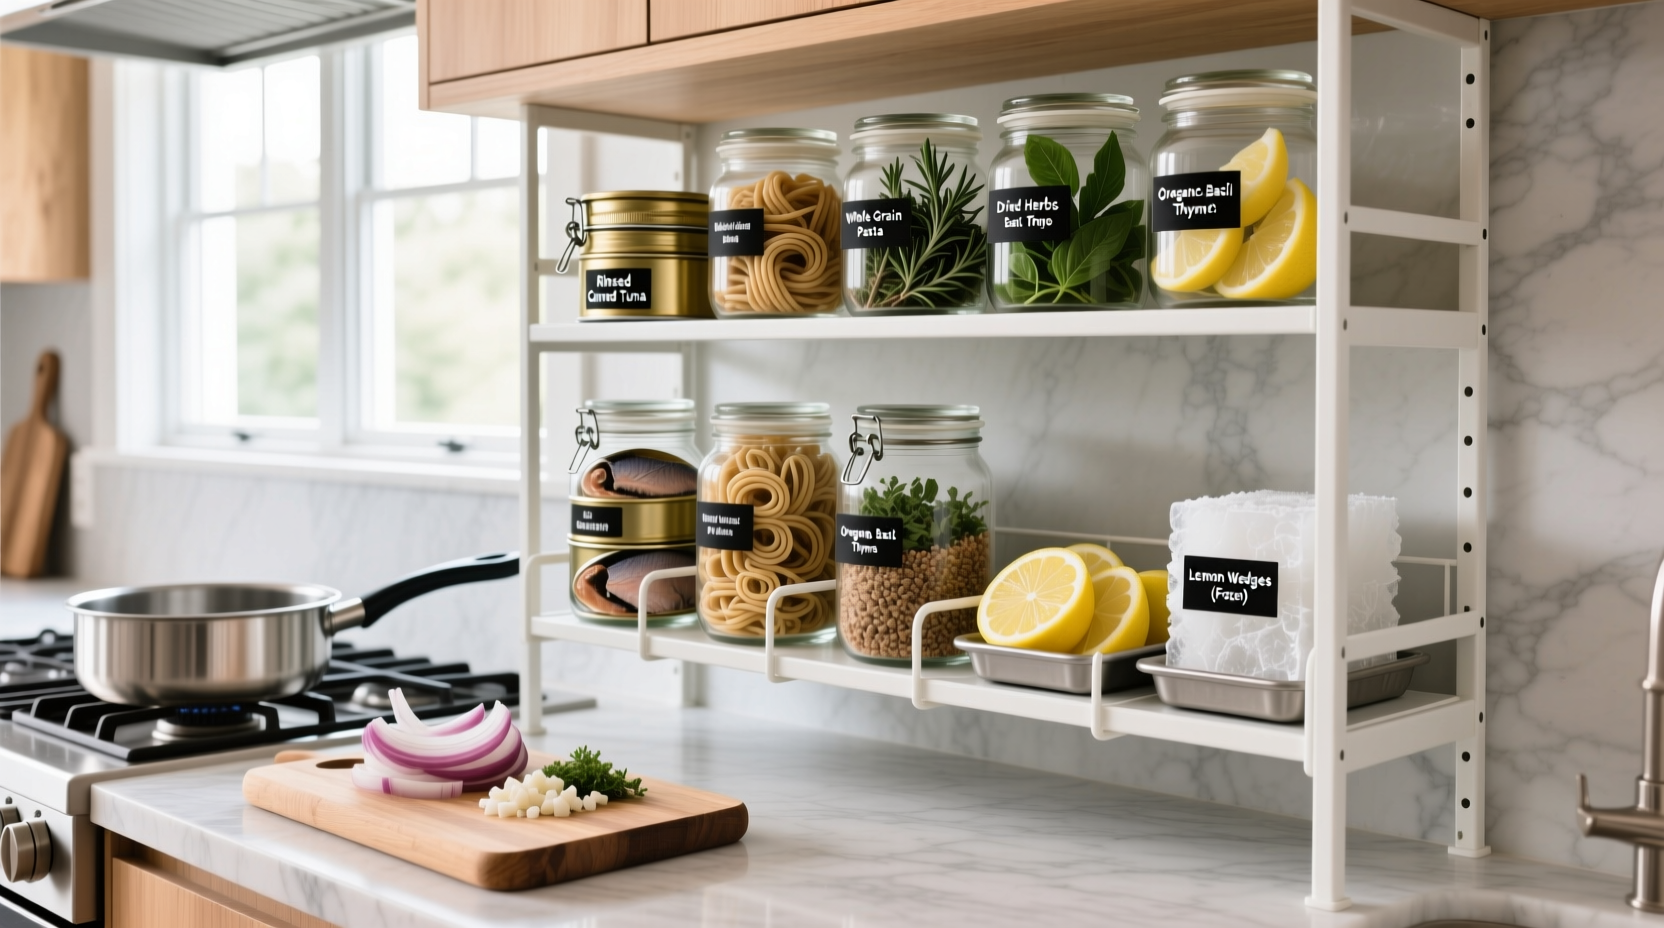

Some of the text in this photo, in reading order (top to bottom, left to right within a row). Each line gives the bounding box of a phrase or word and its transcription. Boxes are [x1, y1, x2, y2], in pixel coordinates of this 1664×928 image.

[1024, 196, 1060, 211] Herbs
[873, 208, 903, 222] Grain
[619, 289, 647, 303] Tuna
[1227, 570, 1272, 590] Wedges
